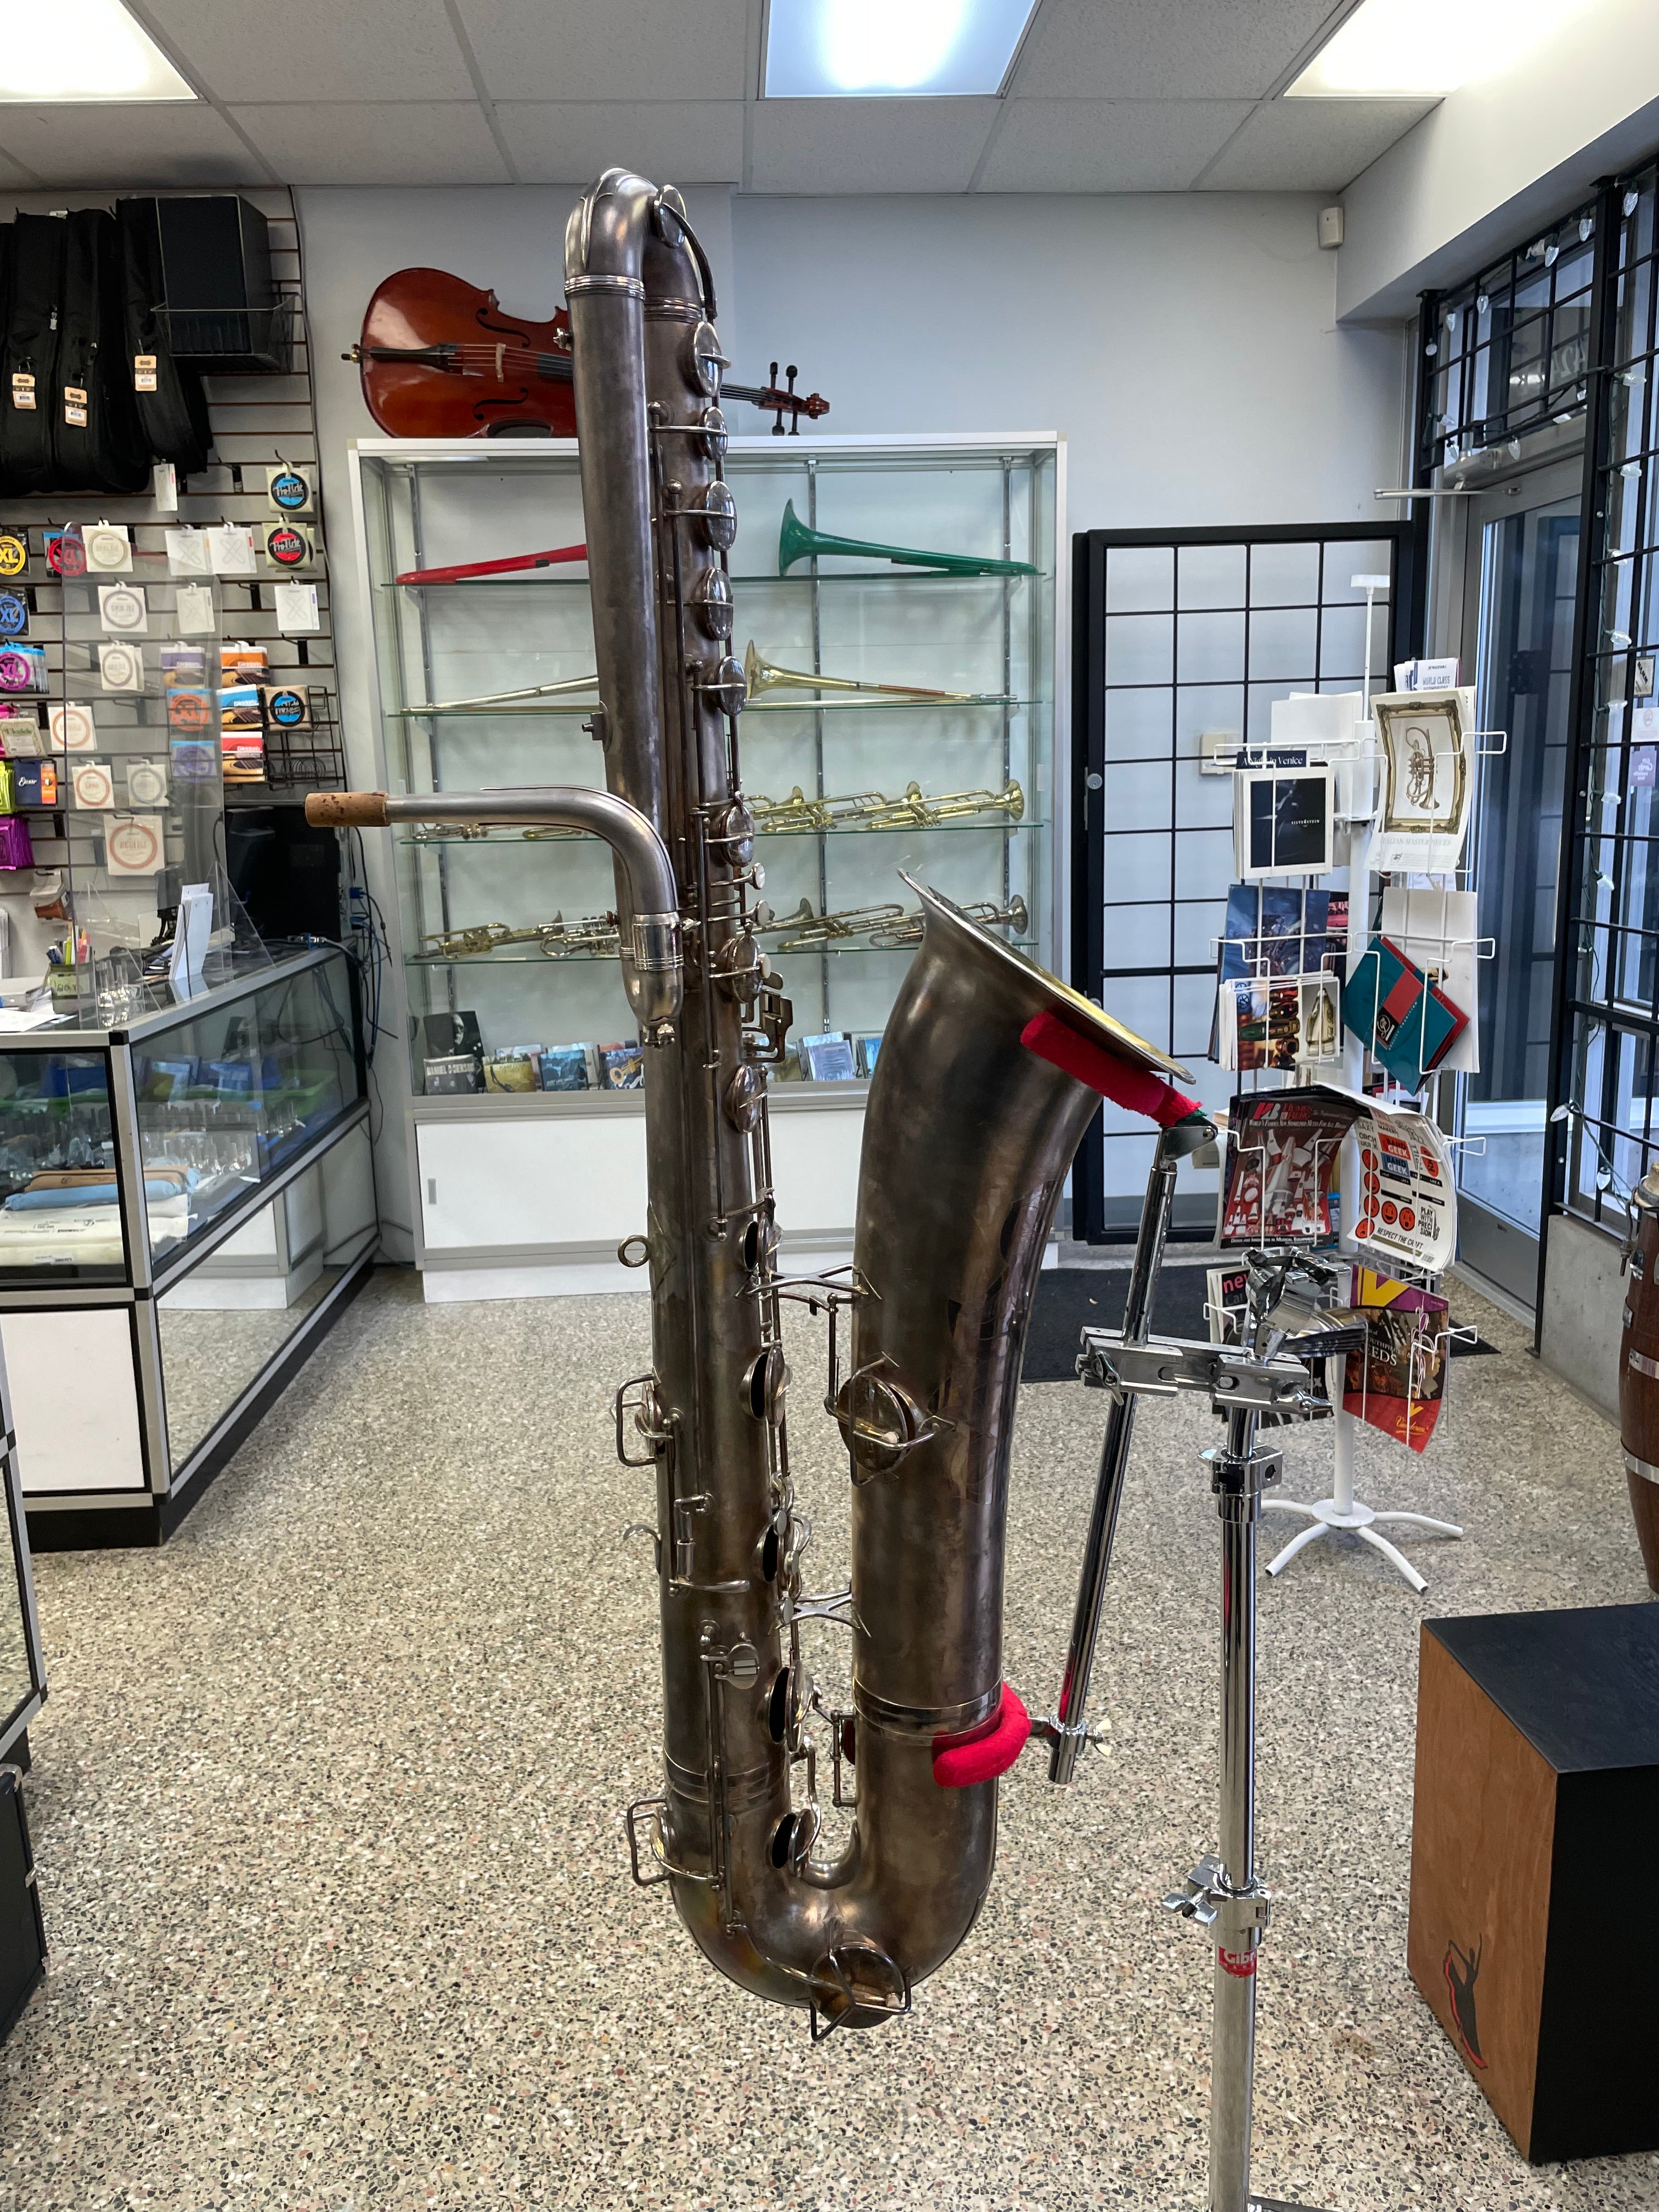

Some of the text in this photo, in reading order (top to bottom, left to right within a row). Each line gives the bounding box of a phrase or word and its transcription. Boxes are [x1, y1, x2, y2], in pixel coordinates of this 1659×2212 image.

[0, 549, 19, 563] XL
[0, 606, 18, 623] XL
[1, 663, 23, 679] XL
[1437, 676, 1451, 685] CLASS
[1278, 756, 1304, 765] Venice
[1386, 1138, 1407, 1149] BAND
[1387, 1146, 1408, 1158] GEEK
[1386, 1156, 1407, 1167] BAND
[1387, 1163, 1408, 1176] GEEK
[1421, 1206, 1434, 1216] PLAY
[1420, 1213, 1433, 1222] WITH
[1418, 1220, 1432, 1229] PRECI
[1376, 1227, 1398, 1242] RESPECT
[1420, 1228, 1431, 1238] SION
